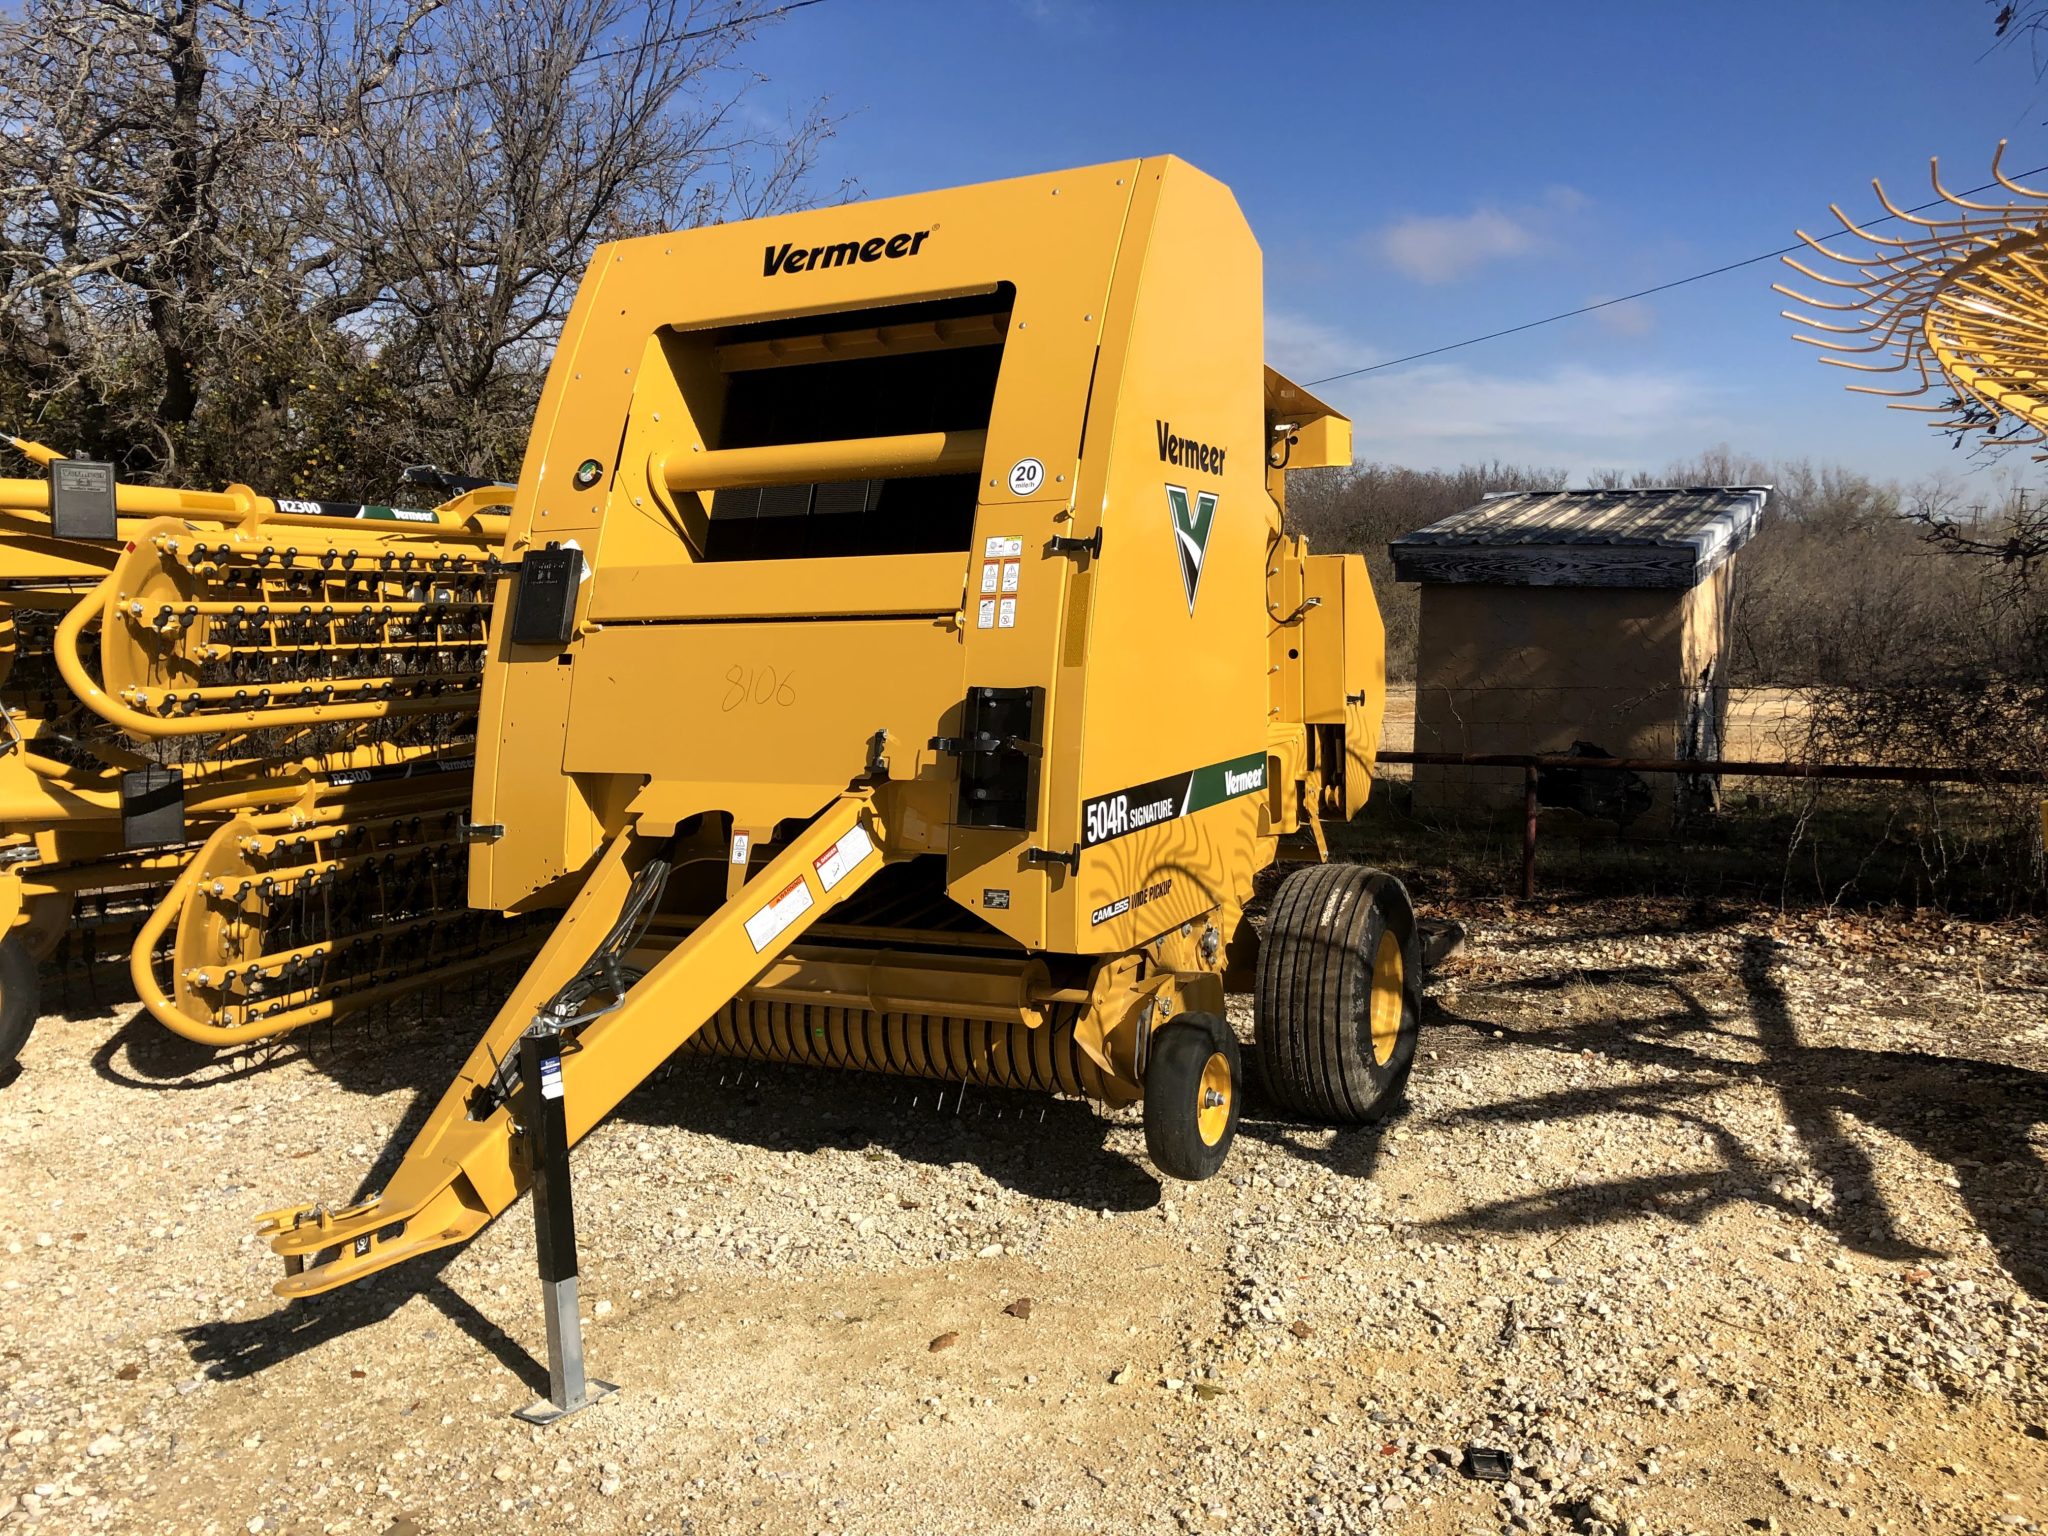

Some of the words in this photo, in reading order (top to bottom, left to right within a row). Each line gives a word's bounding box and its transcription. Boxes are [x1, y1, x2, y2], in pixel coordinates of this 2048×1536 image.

[763, 230, 930, 277] Vermeer
[1156, 419, 1226, 476] Vermeer
[1015, 465, 1037, 482] 20
[277, 500, 321, 514] R2300
[390, 508, 433, 522] Vermeer
[722, 664, 796, 713] 8106
[332, 769, 372, 786] R2300
[436, 759, 475, 771] Vermee
[1086, 794, 1129, 844] 504R
[1129, 797, 1174, 830] SIGNATURE
[1225, 768, 1263, 796] Vermeer
[1092, 898, 1130, 924] CAMLESS
[1131, 887, 1149, 910] WIDE
[1149, 879, 1173, 902] PICKUP
